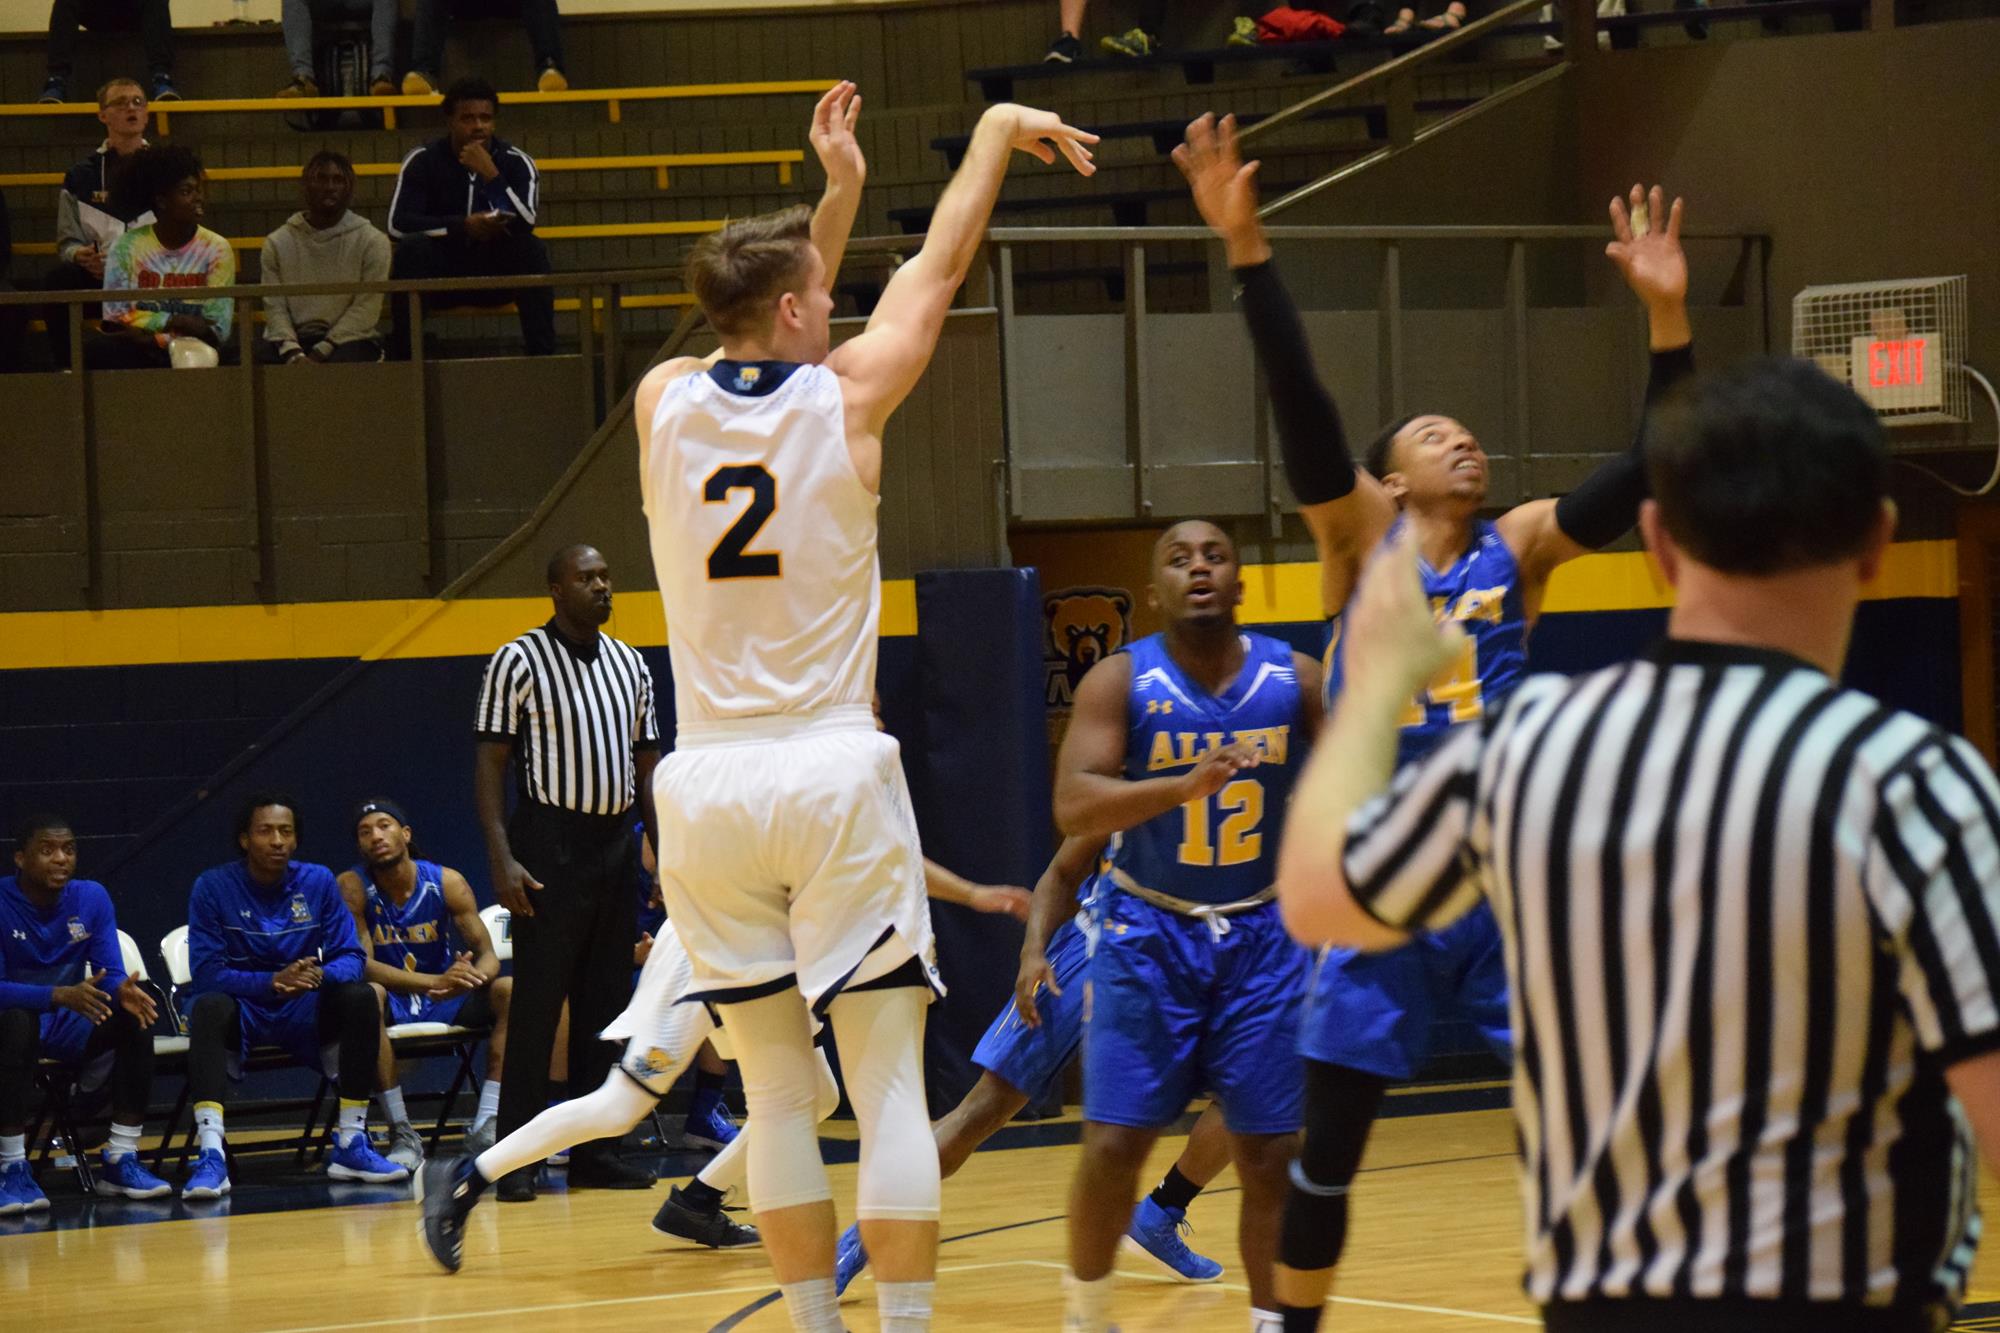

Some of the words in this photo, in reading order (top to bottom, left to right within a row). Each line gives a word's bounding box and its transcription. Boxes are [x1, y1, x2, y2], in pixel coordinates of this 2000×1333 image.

[1868, 339, 1925, 387] EXIT
[702, 461, 783, 582] 2
[1177, 779, 1264, 866] 12
